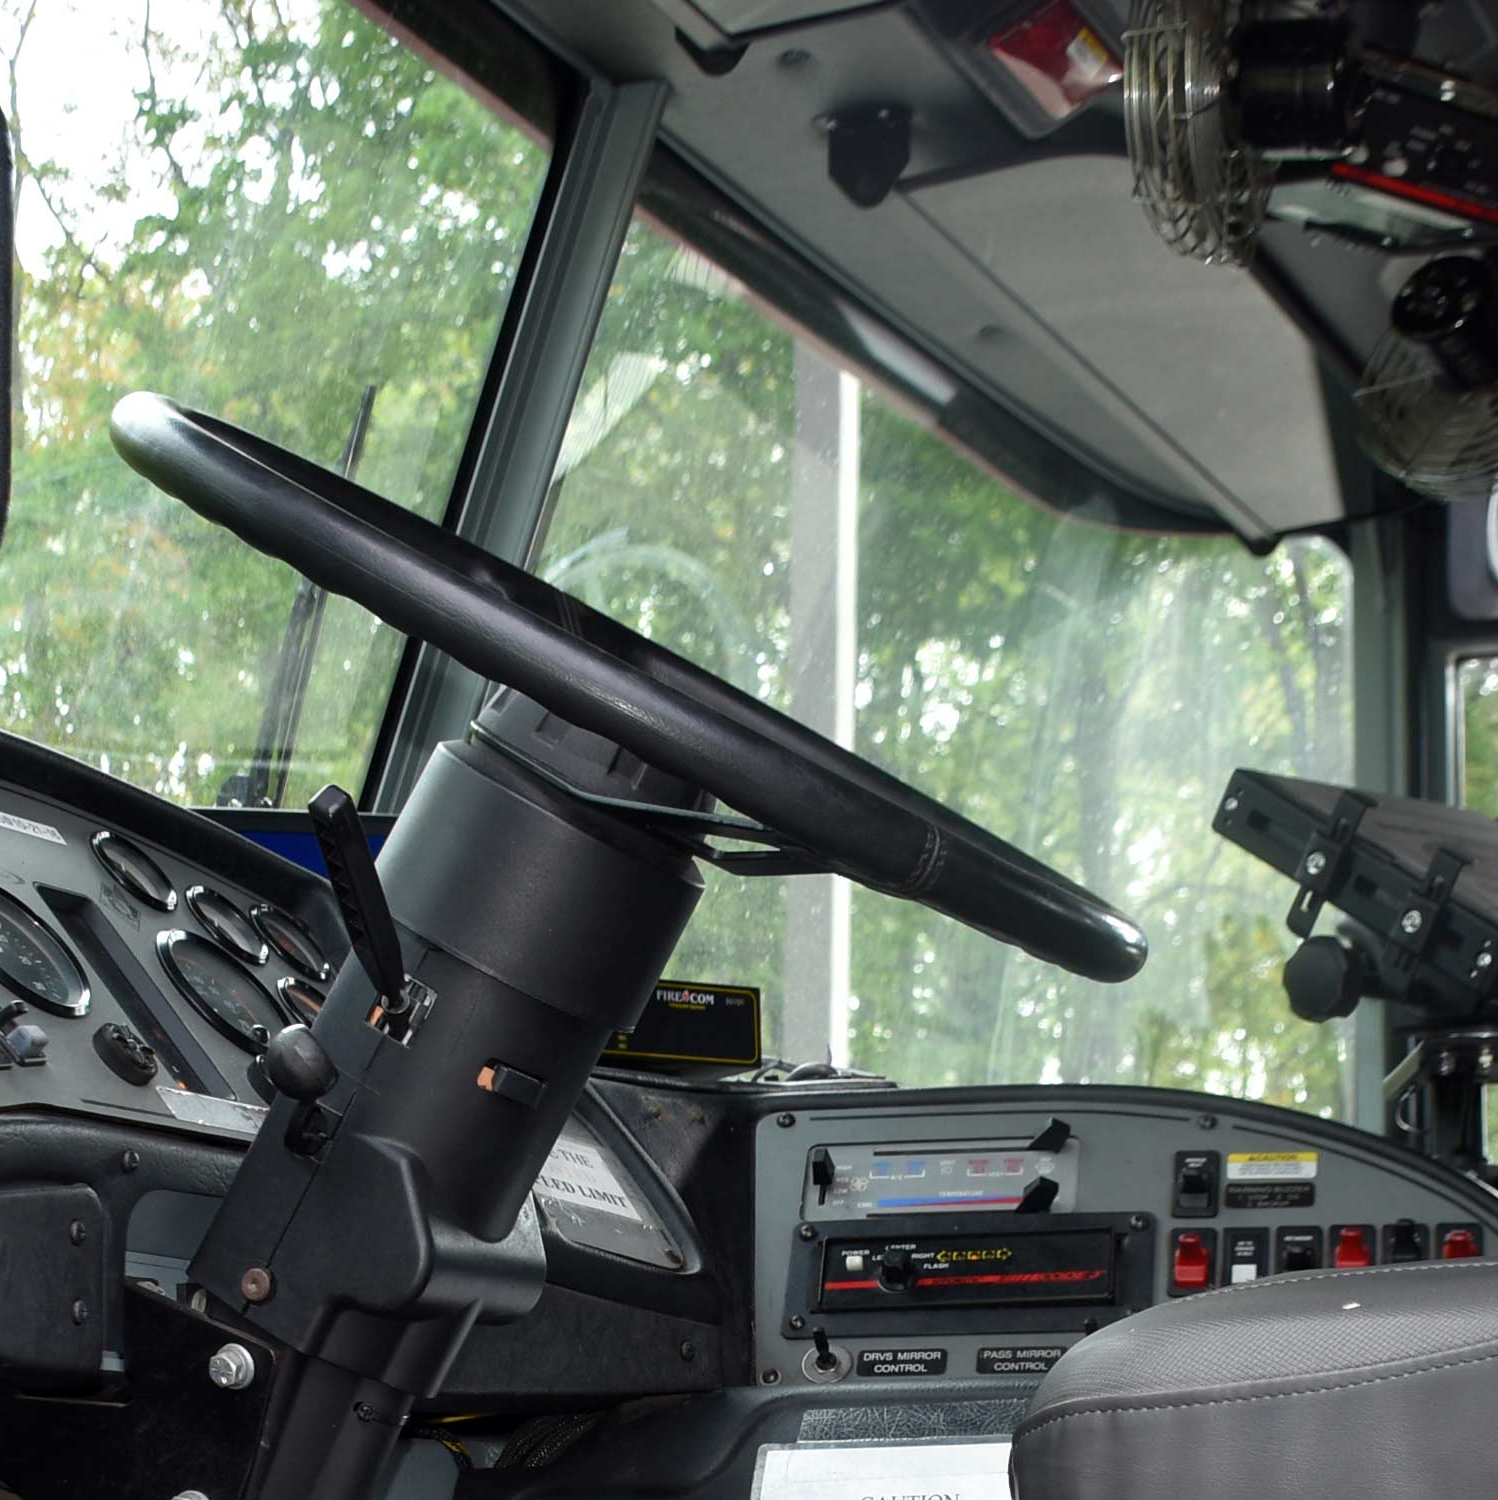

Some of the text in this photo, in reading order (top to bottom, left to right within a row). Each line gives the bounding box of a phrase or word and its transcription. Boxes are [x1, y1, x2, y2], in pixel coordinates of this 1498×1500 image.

[557, 1149, 594, 1168] THE
[535, 1175, 626, 1208] EED LIMIT
[923, 1263, 949, 1271] FLASH
[863, 1351, 941, 1362] DRVS MIRROR
[983, 1349, 1061, 1360] PASS MIRROR
[874, 1363, 927, 1373] CONTROL
[994, 1362, 1049, 1372] CONTROL
